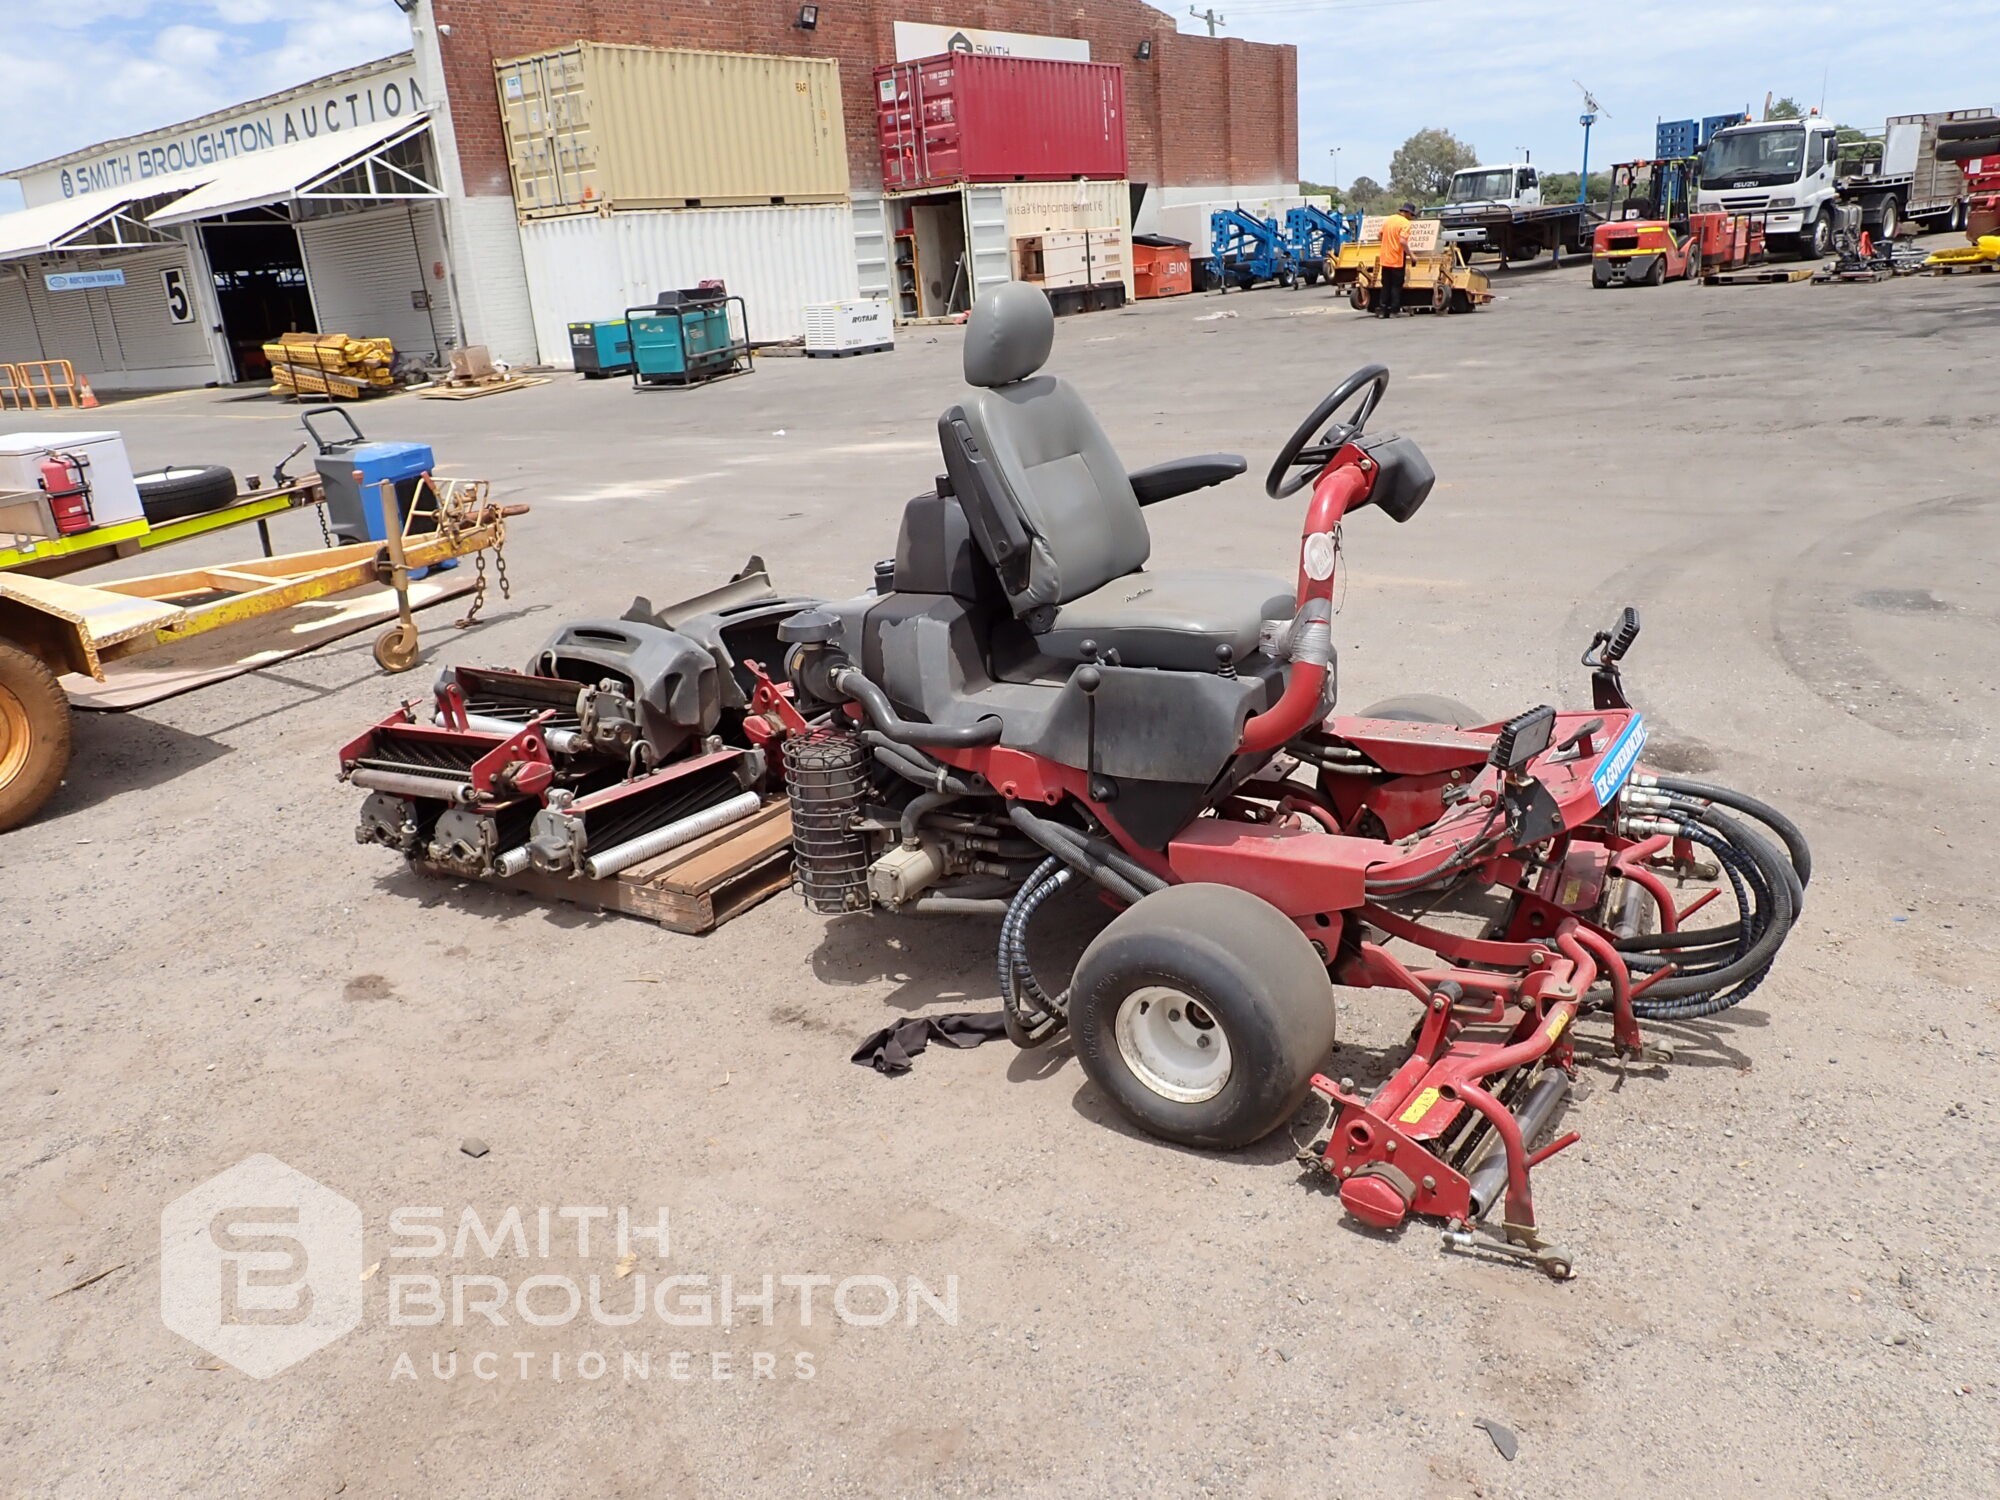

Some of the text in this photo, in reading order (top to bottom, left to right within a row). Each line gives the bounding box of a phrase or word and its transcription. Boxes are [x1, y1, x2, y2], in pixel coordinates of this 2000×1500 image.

[77, 155, 132, 193] SMITH
[138, 118, 274, 178] BROUGHTON
[1733, 180, 1759, 188] ISUZU
[69, 275, 95, 284] AUCTION
[96, 273, 115, 282] ROOM
[165, 270, 188, 320] 5
